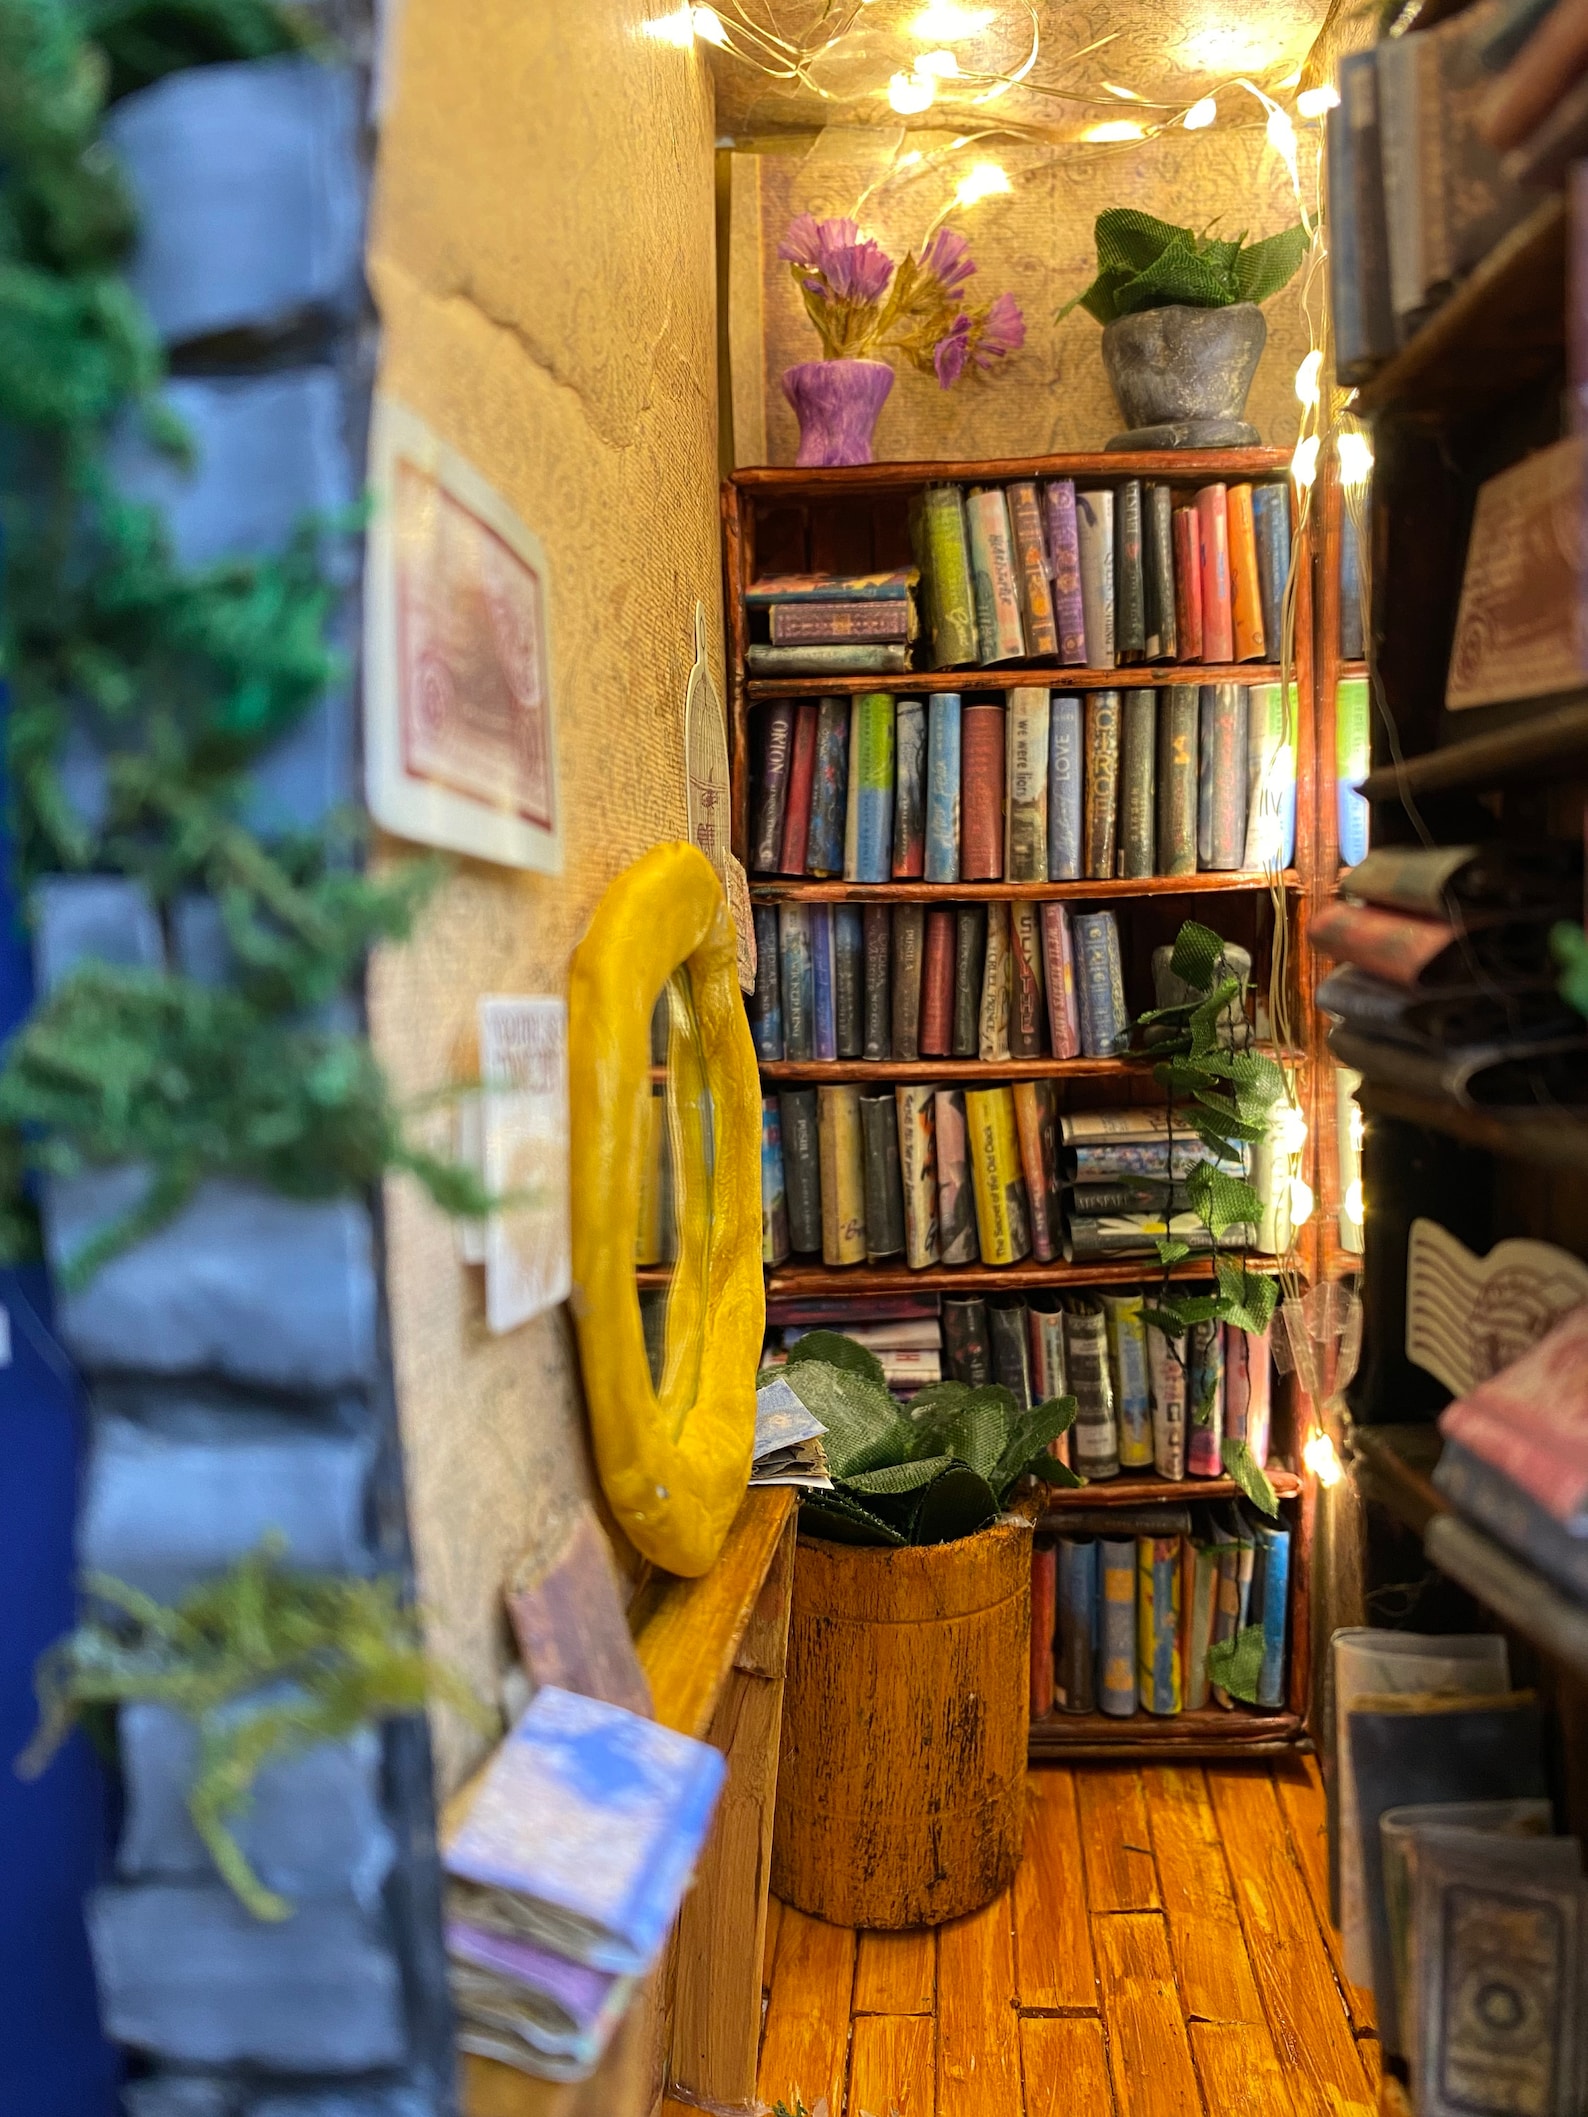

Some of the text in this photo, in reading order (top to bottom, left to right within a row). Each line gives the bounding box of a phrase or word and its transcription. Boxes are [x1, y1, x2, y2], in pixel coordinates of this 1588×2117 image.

[768, 721, 788, 774] ORION
[1014, 720, 1032, 797] we were liars
[1055, 734, 1071, 781] LOVE
[790, 1008, 801, 1037] KING
[986, 952, 998, 1032] CRUEL PRINCE
[983, 1125, 1005, 1258] The Secret of the Old Clock
